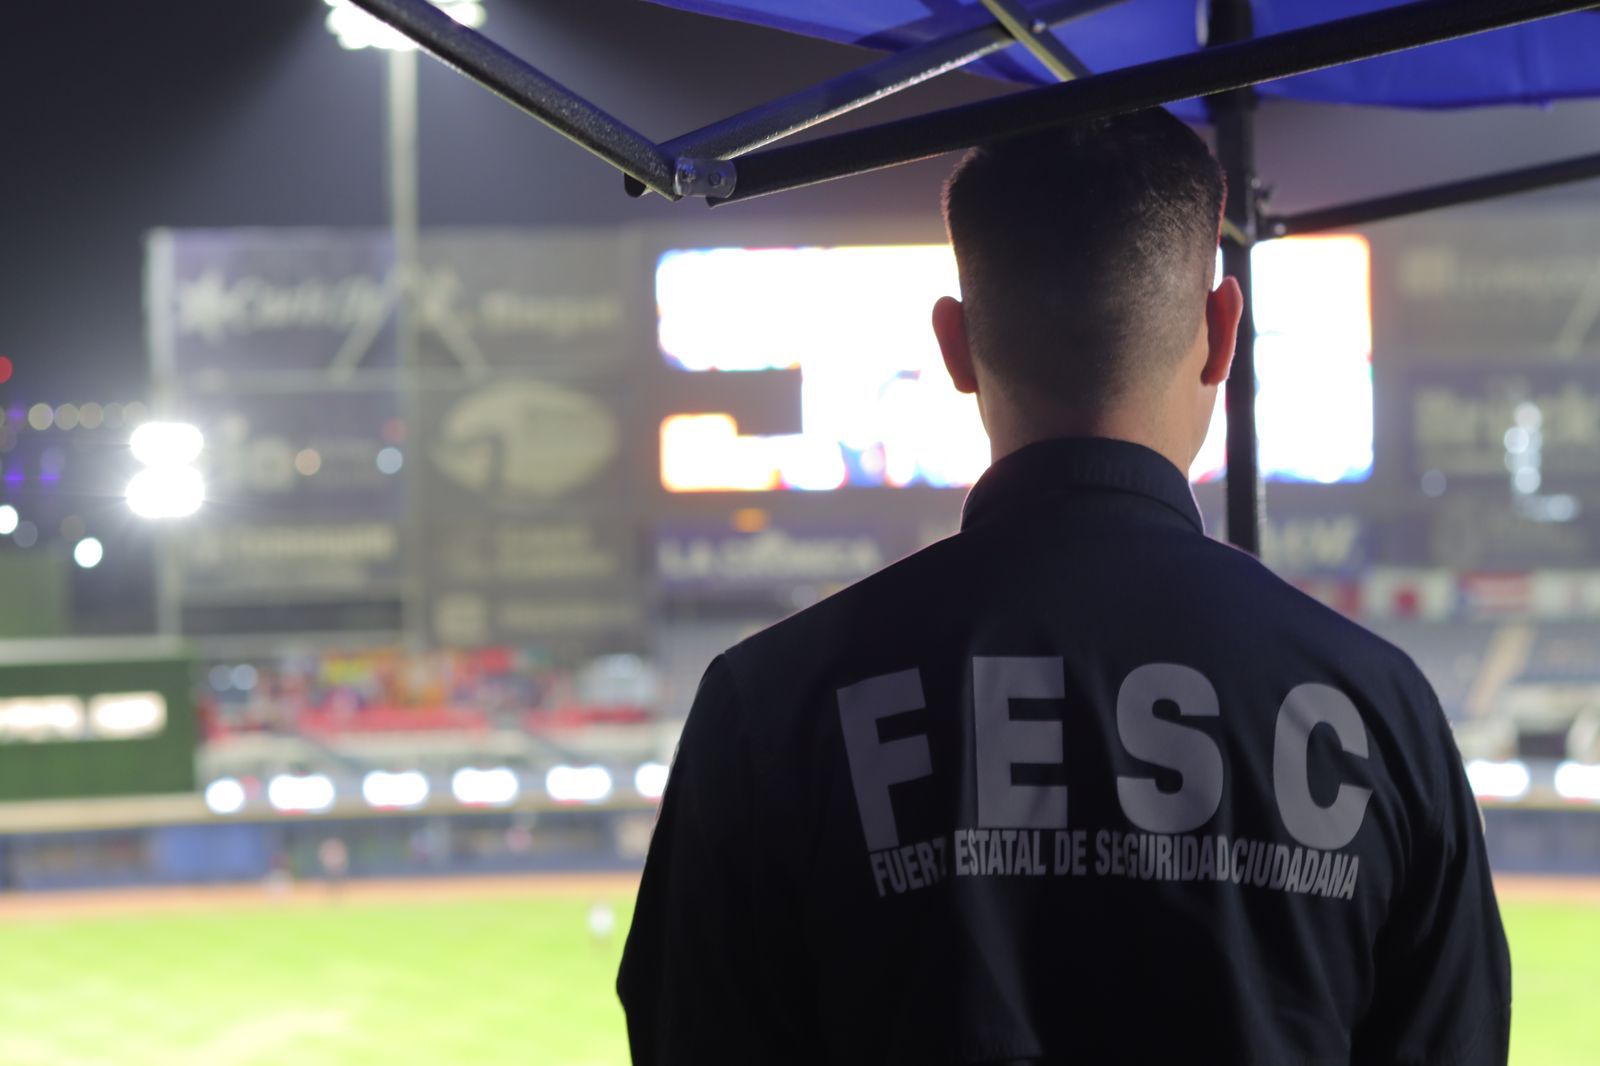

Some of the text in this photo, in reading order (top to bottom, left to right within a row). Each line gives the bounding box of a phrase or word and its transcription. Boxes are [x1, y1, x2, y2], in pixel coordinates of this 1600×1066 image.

[836, 655, 1371, 850] FESC
[954, 829, 1047, 876] ESTATAL
[1055, 830, 1088, 876] DE
[1094, 829, 1231, 881] SEGURIDAD
[1231, 839, 1360, 900] CIUDADANA
